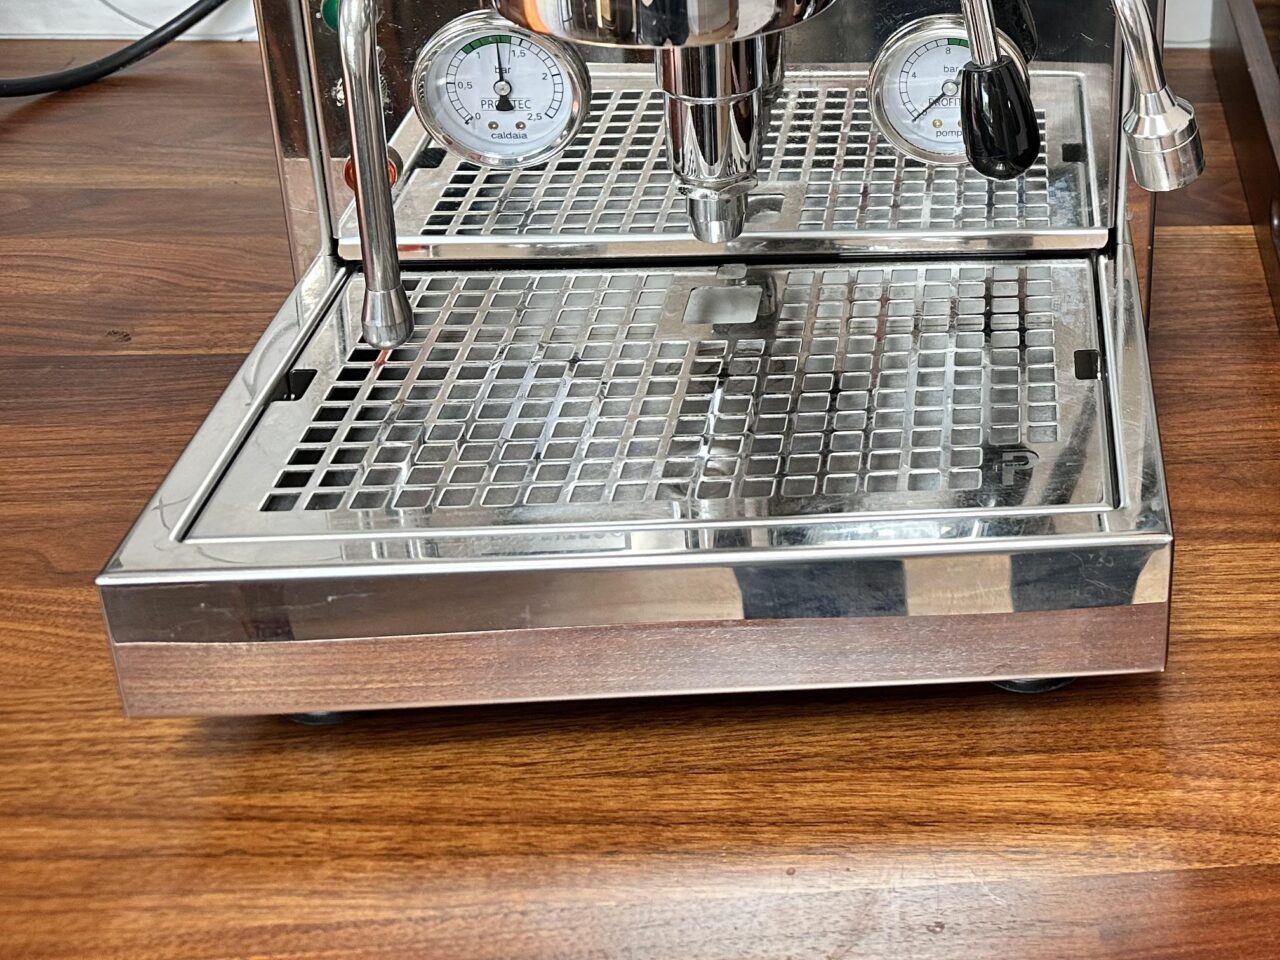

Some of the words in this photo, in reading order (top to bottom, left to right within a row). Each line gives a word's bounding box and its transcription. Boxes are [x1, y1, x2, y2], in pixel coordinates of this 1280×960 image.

[476, 51, 481, 59] 1
[512, 49, 526, 58] 1,5
[494, 66, 511, 74] bar
[943, 65, 959, 73] bar
[542, 72, 548, 80] 2
[457, 81, 473, 90] 0,5
[481, 99, 532, 109] PRTEC
[928, 97, 962, 107] PROFIT
[527, 113, 543, 121] 2,5
[491, 132, 528, 140] caldaia
[936, 130, 963, 138] pomp
